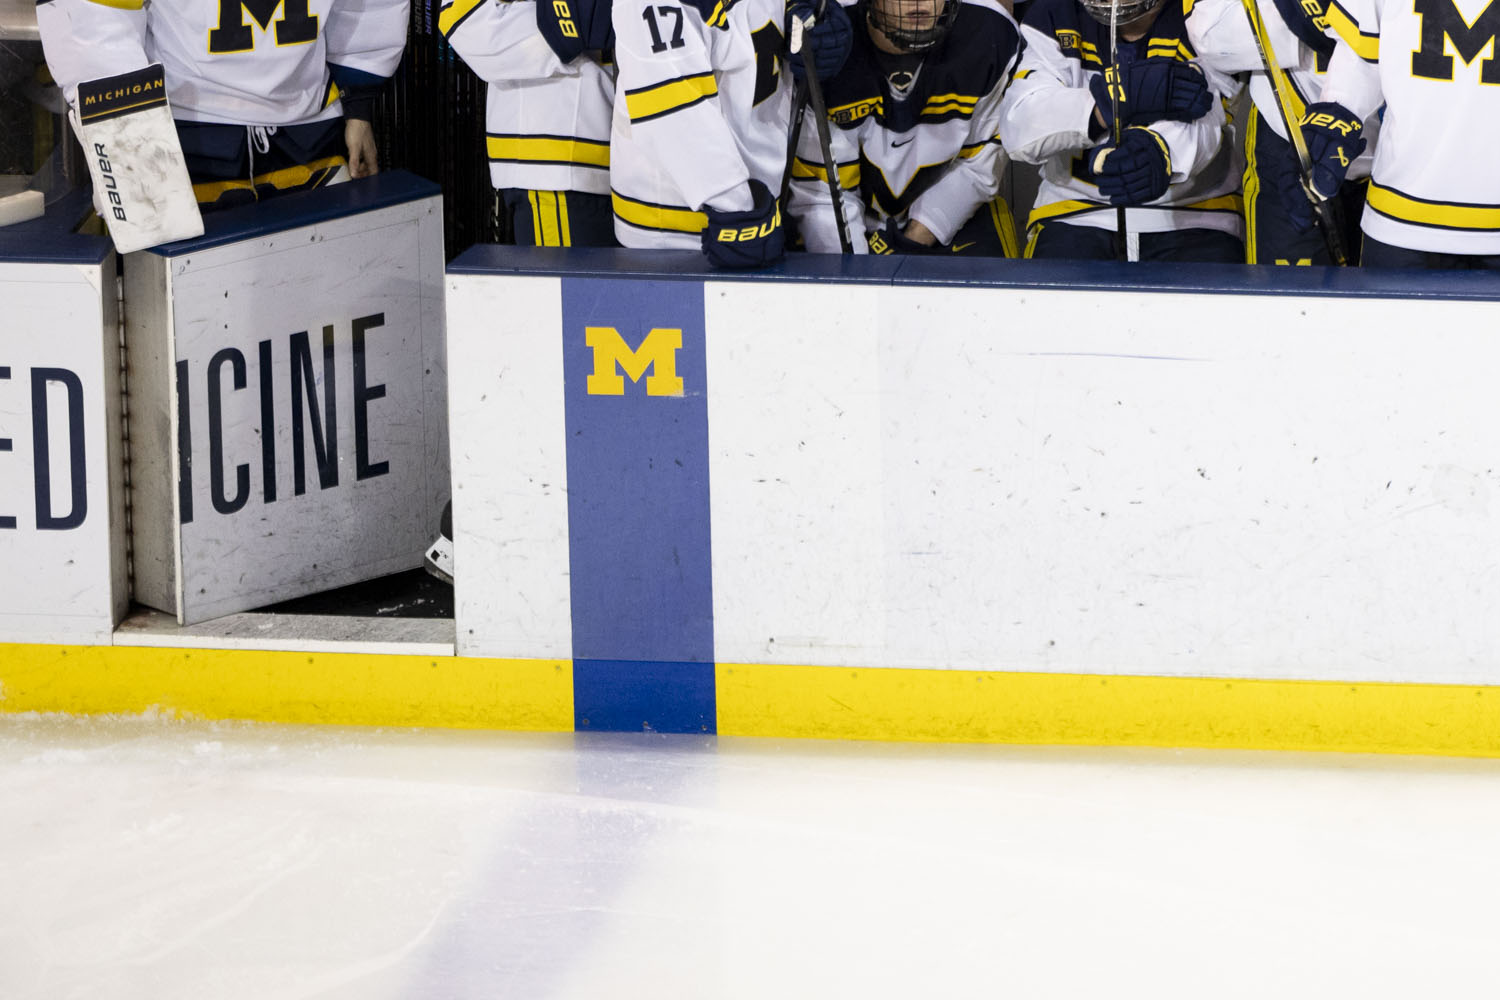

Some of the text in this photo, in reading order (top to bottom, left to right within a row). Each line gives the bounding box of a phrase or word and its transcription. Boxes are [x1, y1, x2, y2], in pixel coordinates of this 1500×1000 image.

[642, 5, 685, 54] 17
[85, 78, 164, 106] MICHIGAN
[94, 142, 127, 222] BAUER
[585, 326, 683, 397] M
